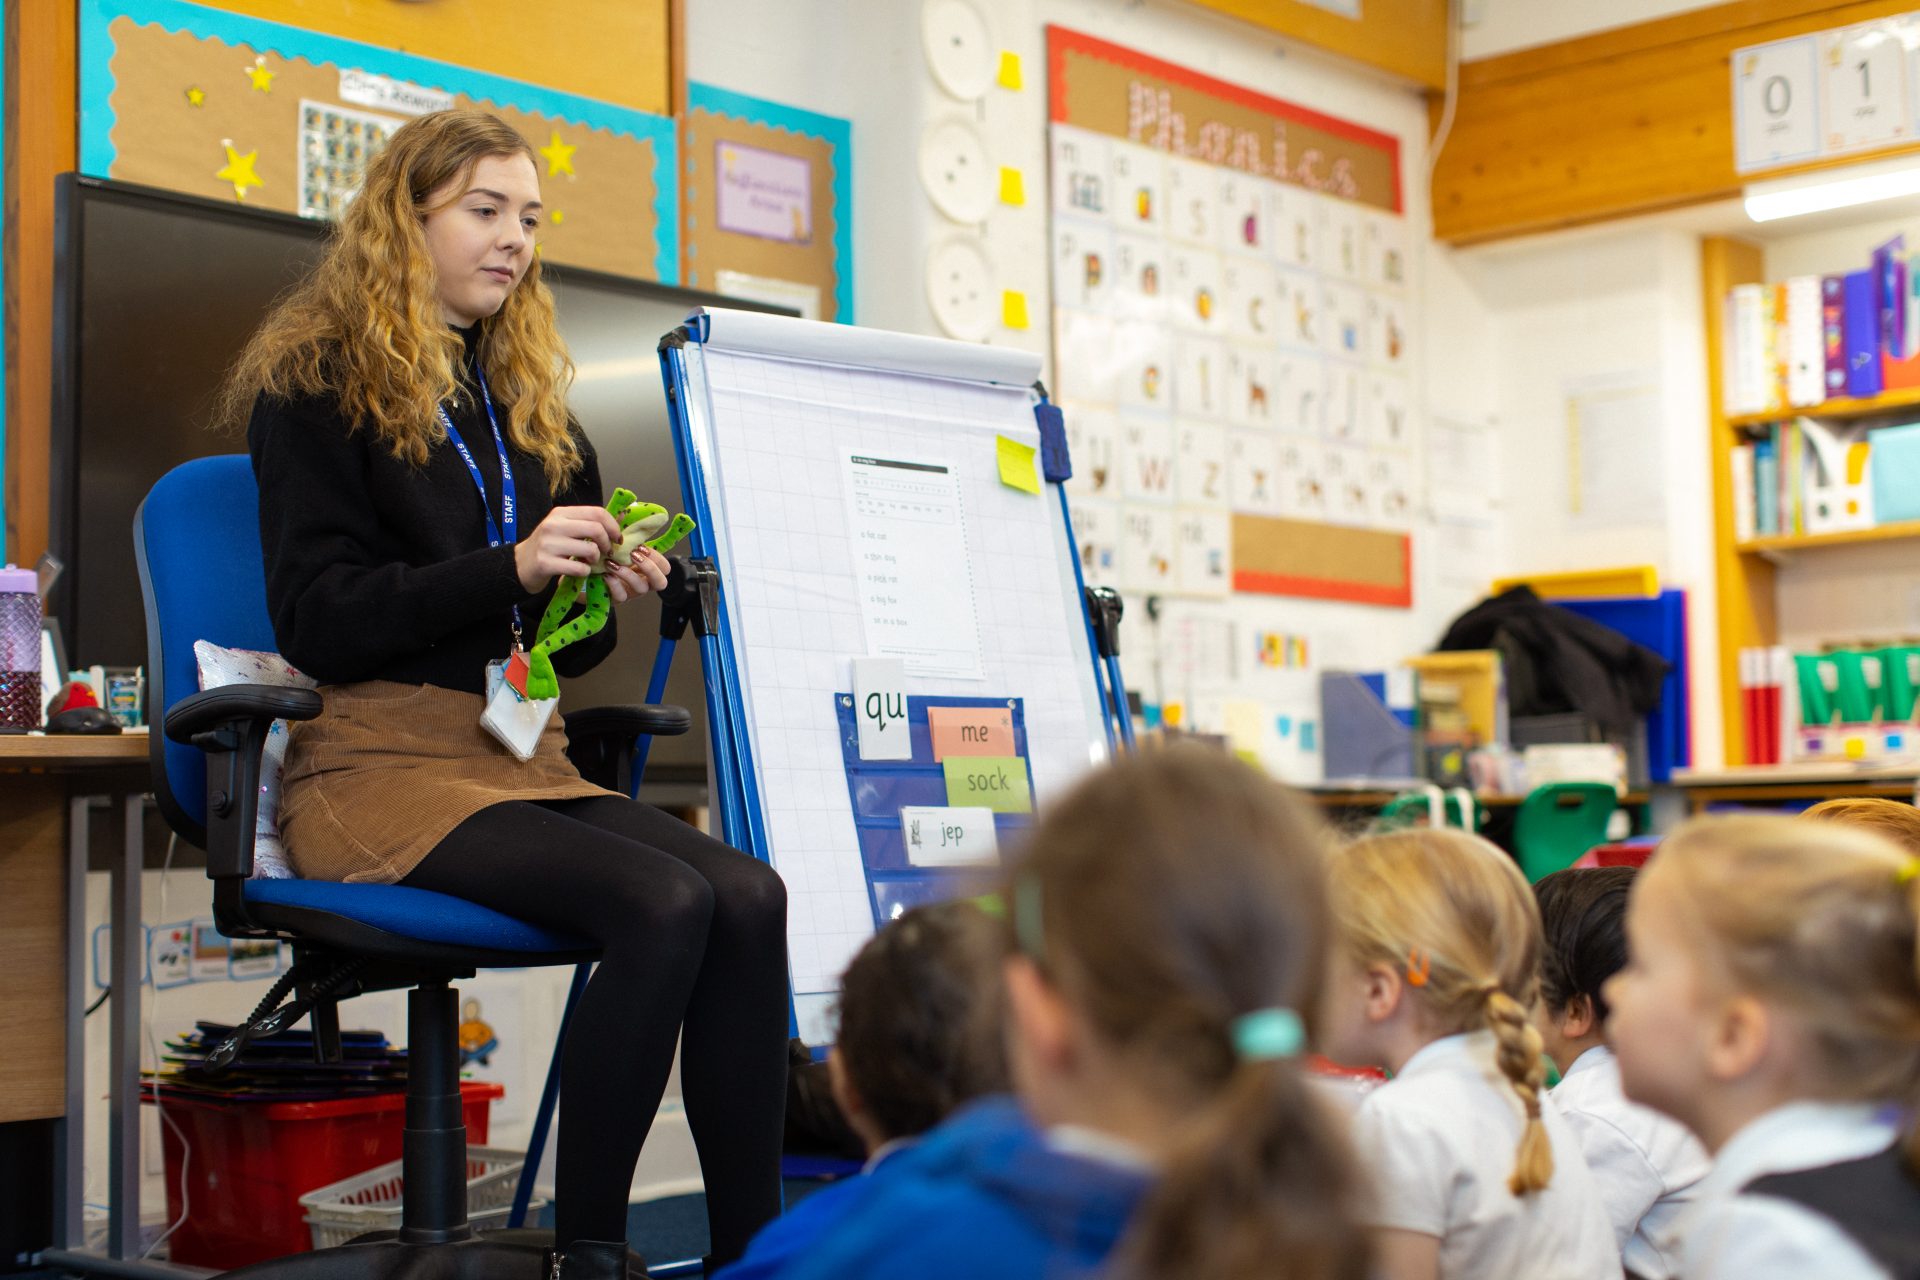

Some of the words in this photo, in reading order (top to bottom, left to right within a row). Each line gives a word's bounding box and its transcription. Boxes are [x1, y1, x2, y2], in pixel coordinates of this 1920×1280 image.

[1857, 59, 1871, 97] 1
[1763, 75, 1792, 117] 0
[1127, 79, 1360, 201] Phonics
[437, 403, 453, 428] TAFF
[457, 443, 478, 470] STAFF
[500, 453, 512, 480] STAFF
[504, 495, 514, 524] STAFF
[865, 692, 905, 732] qu
[961, 724, 989, 742] me
[967, 766, 1011, 792] sock
[940, 822, 963, 847] jep
